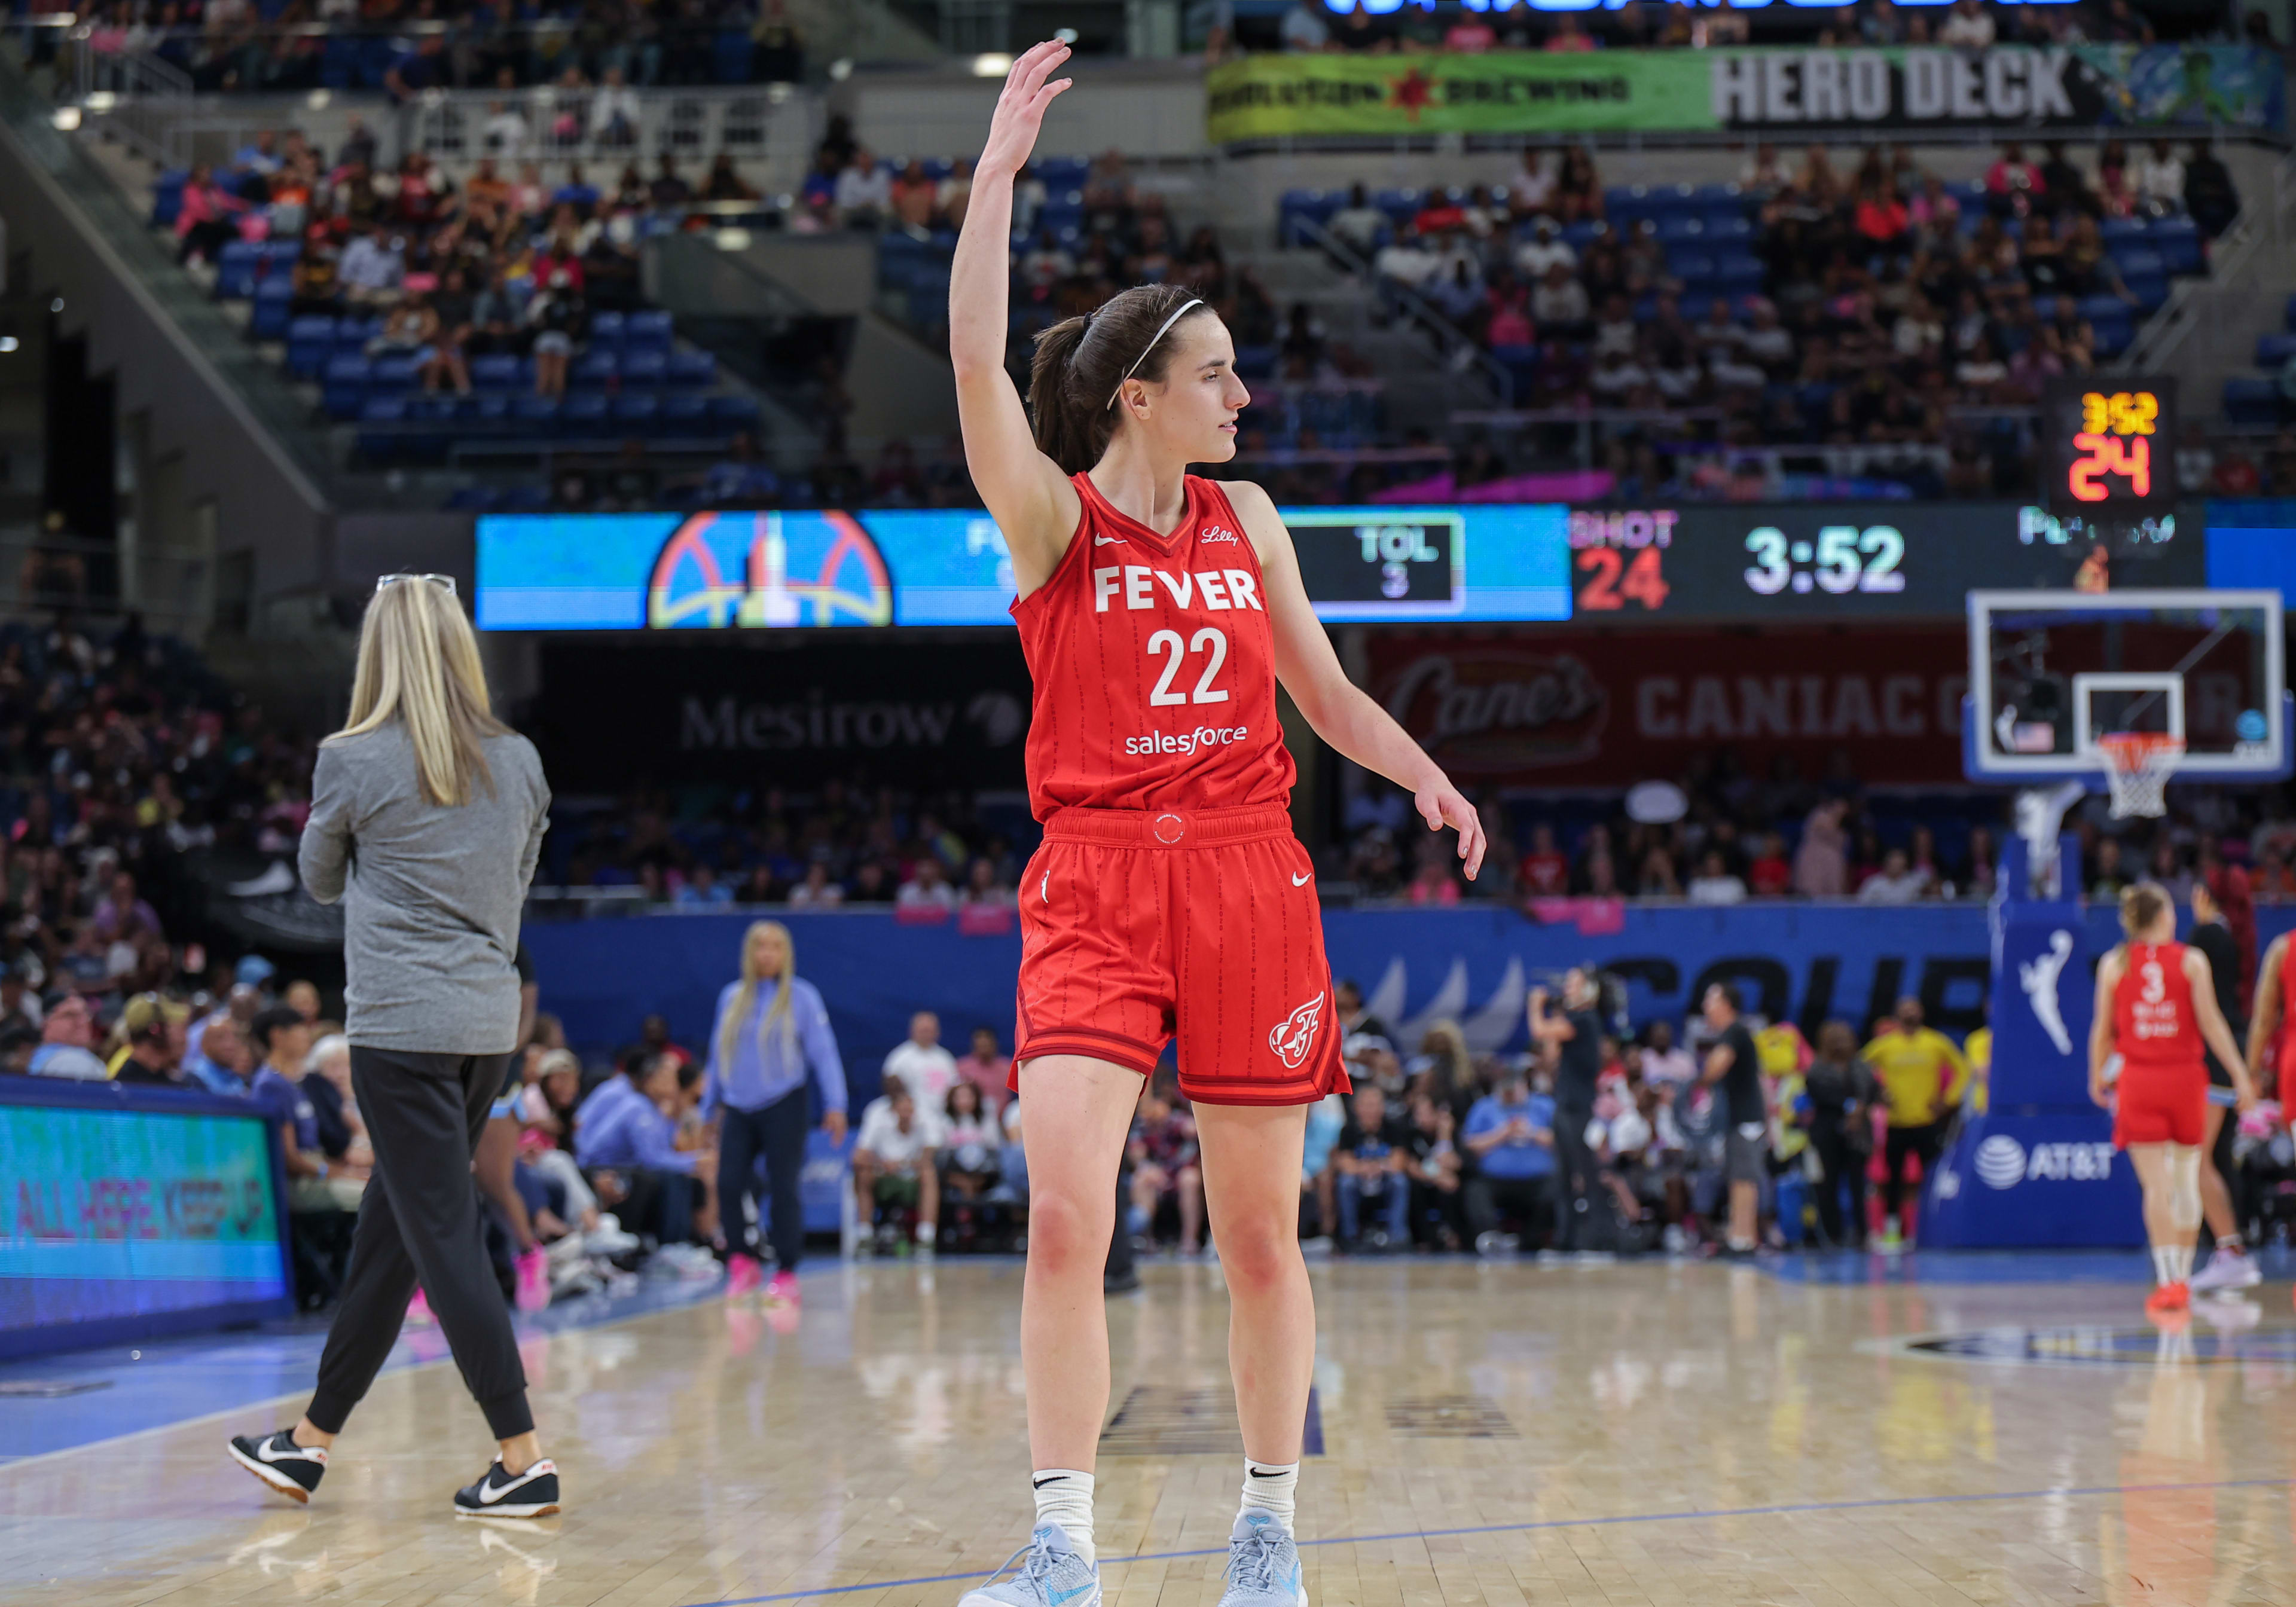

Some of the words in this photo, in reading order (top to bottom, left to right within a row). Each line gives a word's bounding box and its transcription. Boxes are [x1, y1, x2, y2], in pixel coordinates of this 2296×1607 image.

[1711, 50, 1891, 119] HERO
[1903, 48, 2074, 119] DECK
[2069, 432, 2151, 502] 24
[1201, 526, 1239, 547] Lilly
[1354, 525, 1440, 562] TOL
[1568, 510, 1680, 548] SHOT
[1744, 525, 1906, 595] 3:52
[1094, 565, 1263, 613] FEVER
[1577, 546, 1671, 610] 24
[1147, 627, 1229, 707] 22
[1386, 653, 1600, 737] Cane's
[680, 686, 955, 750] Mesirow
[1636, 676, 1926, 738] CANIAC
[1125, 725, 1248, 756] salesforce
[2140, 961, 2166, 1006] 3
[2026, 1141, 2118, 1181] AT&T
